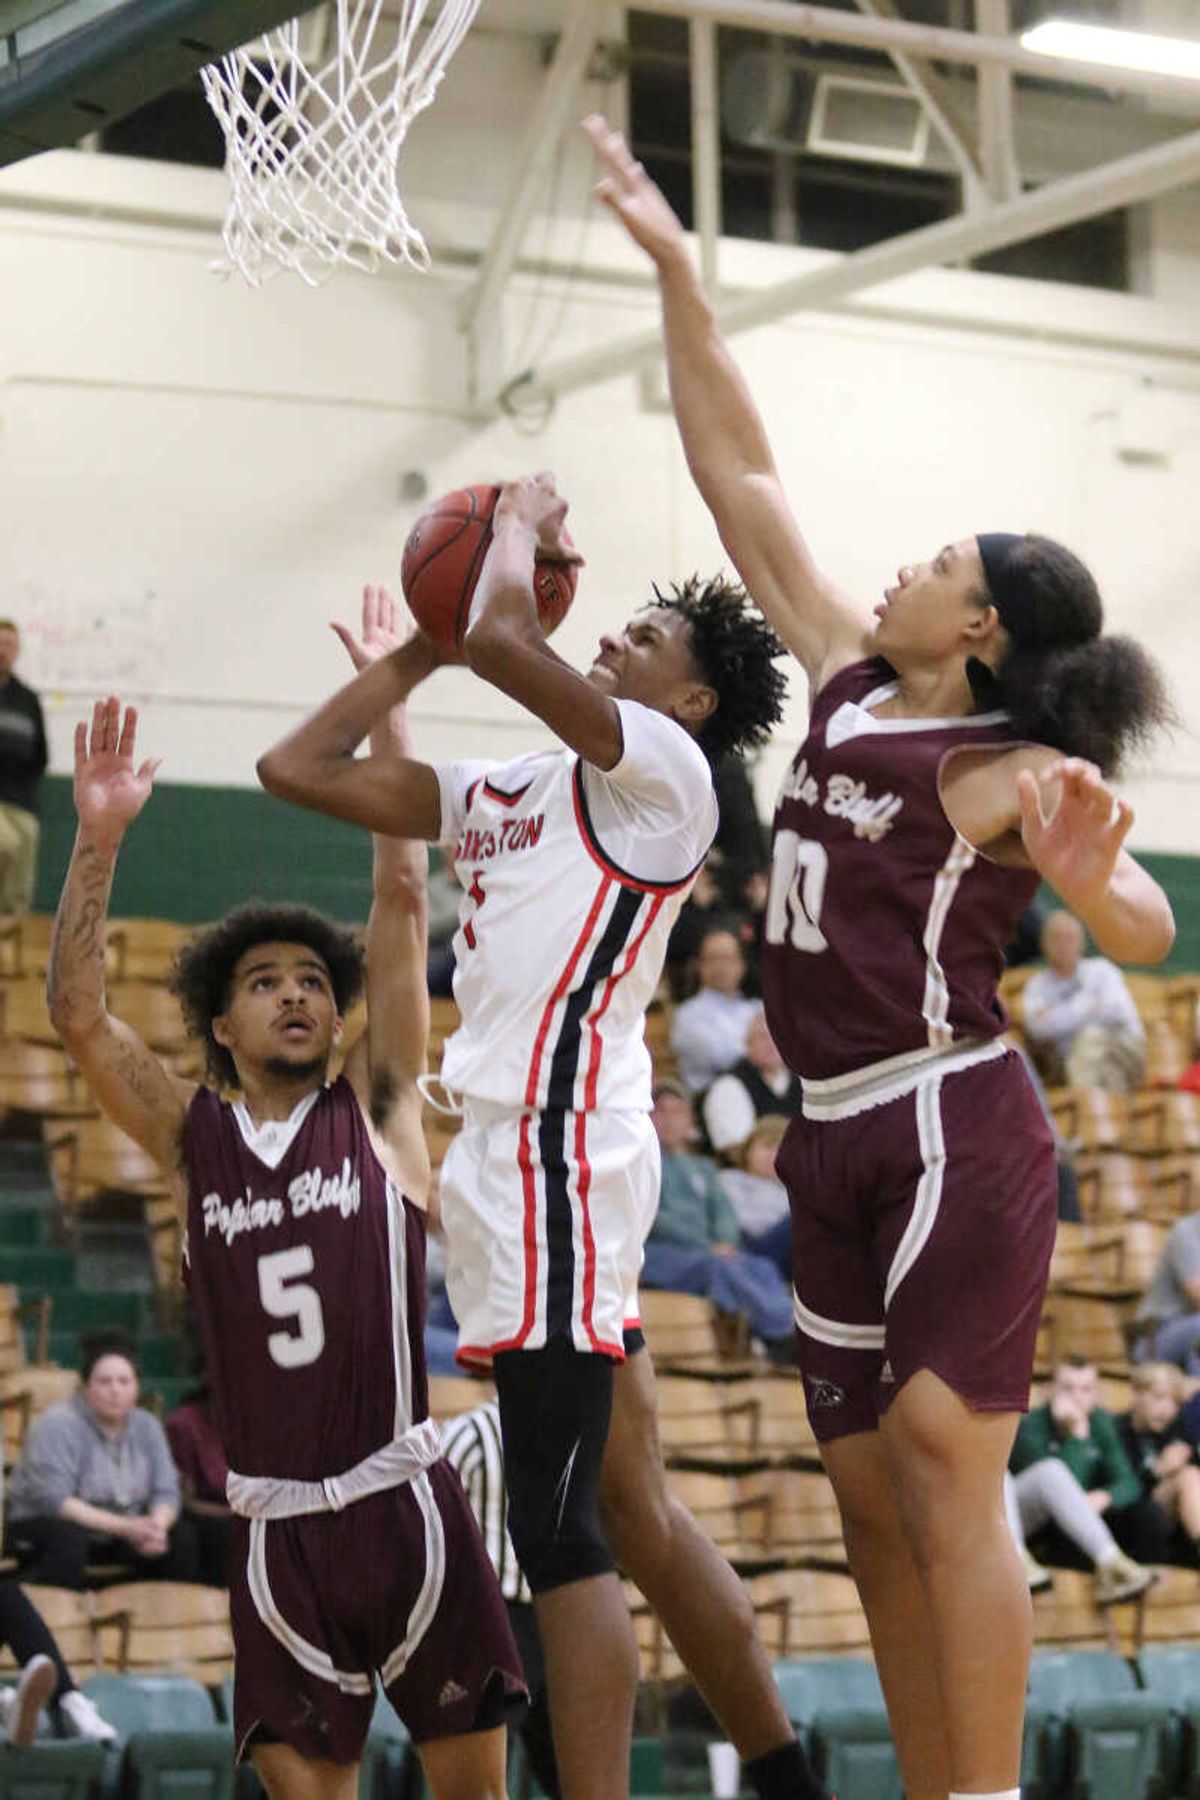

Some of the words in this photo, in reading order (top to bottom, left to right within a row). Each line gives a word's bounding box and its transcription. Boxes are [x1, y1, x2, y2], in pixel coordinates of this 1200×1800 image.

[765, 828, 829, 954] 10
[287, 1156, 361, 1220] Bluff
[257, 1244, 325, 1369] 5
